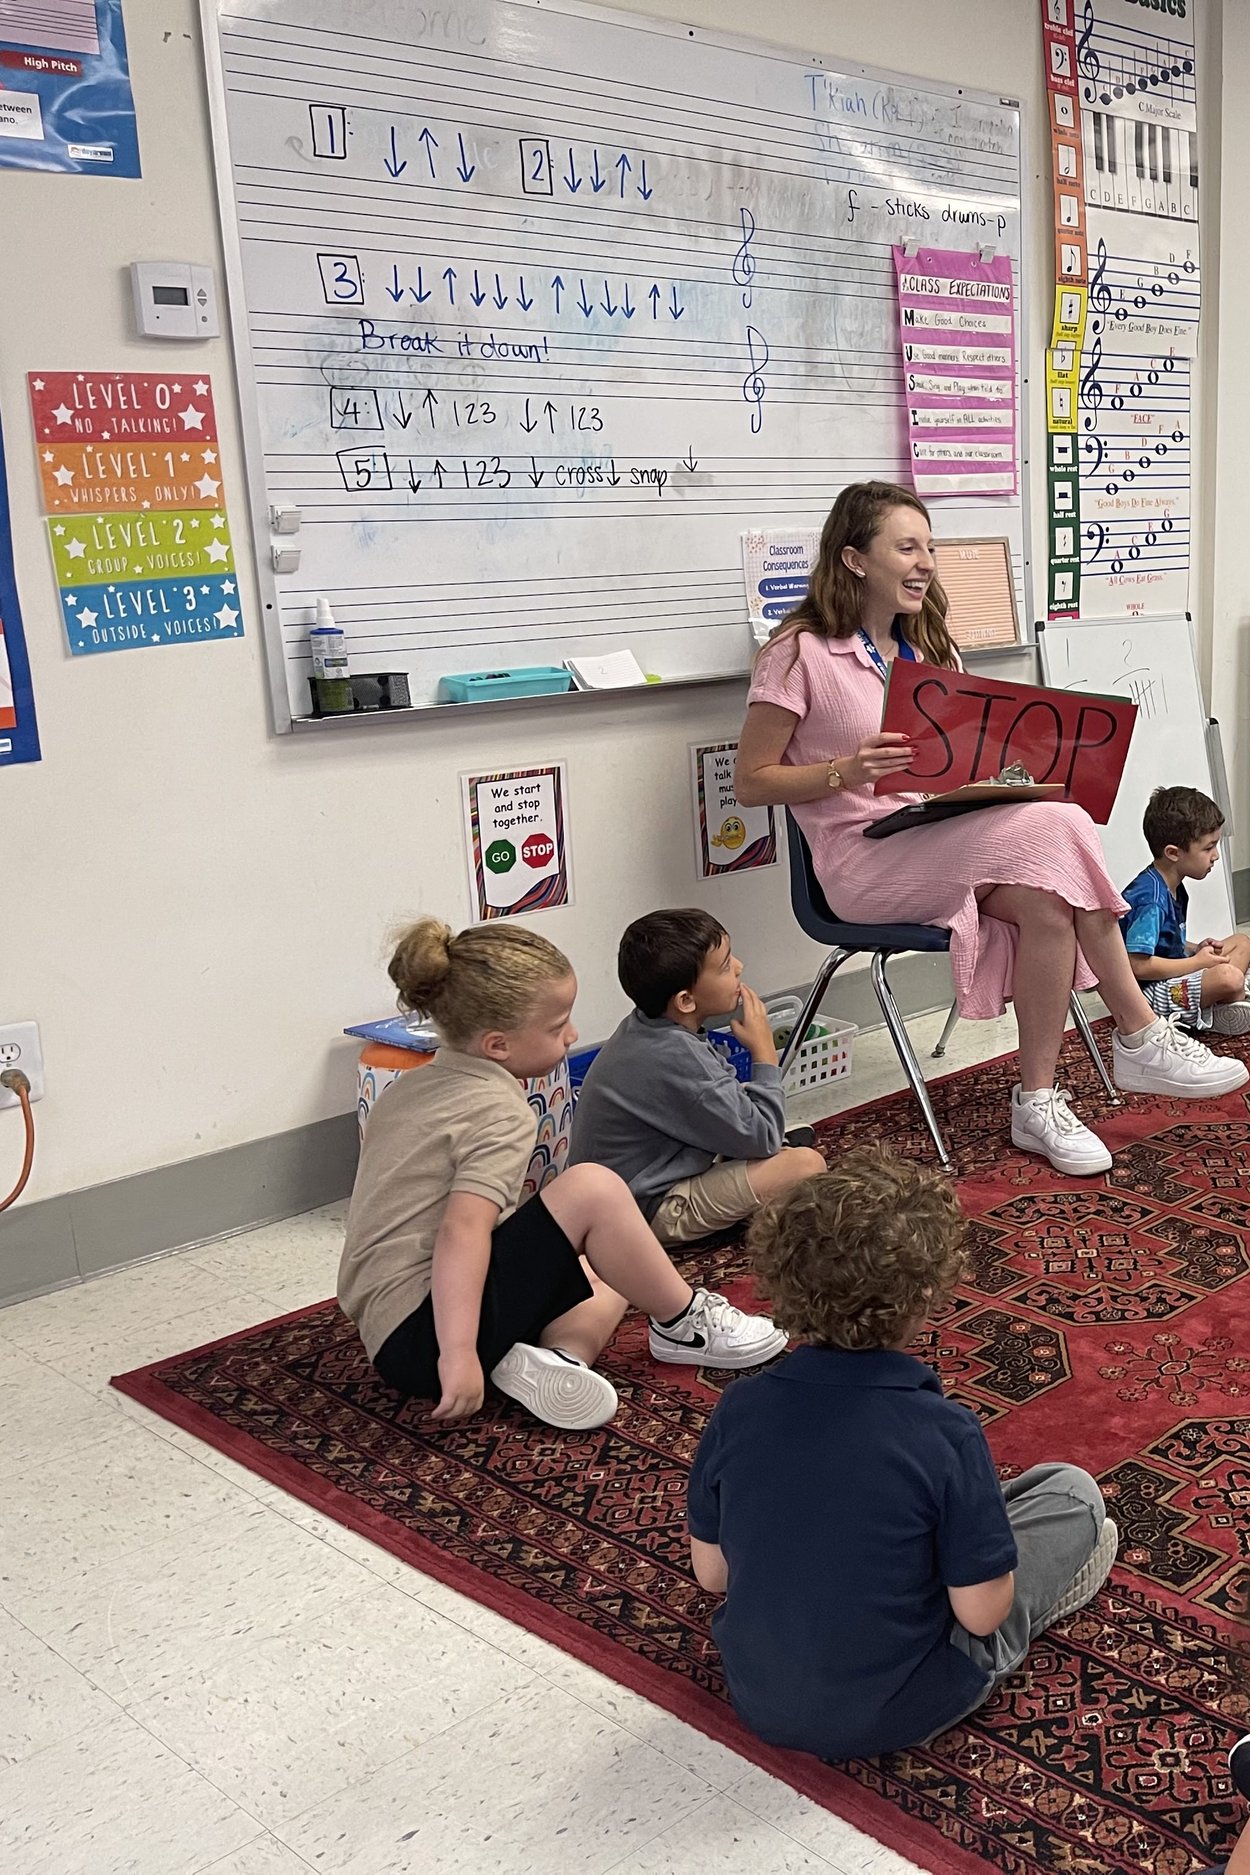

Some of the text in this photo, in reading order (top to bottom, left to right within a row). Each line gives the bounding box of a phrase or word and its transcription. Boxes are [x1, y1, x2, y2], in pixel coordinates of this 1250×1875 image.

[24, 57, 77, 72] High Pitch
[887, 198, 931, 220] sticks
[1090, 189, 1097, 200] C
[1104, 192, 1111, 202] D
[1118, 194, 1124, 205] E
[1158, 201, 1165, 212] A
[1171, 202, 1177, 213] B
[1183, 205, 1190, 215] C
[1119, 250, 1191, 300] E G B D F
[909, 277, 1010, 300] CLASS EXPECTATIONS
[904, 309, 986, 328] Make Good Choices
[1128, 322, 1145, 332] Good
[359, 319, 551, 363] Break it down!
[72, 383, 142, 410] LEVEL
[74, 416, 177, 434] NO TALKING!
[453, 402, 498, 427] 123
[570, 407, 604, 433] 123
[82, 452, 175, 480] LEVEL 1
[462, 456, 512, 489] 123
[555, 464, 604, 487] cross
[629, 464, 669, 497] snap
[70, 485, 196, 504] WHISPERS ONLY!
[92, 519, 186, 550] LEVEL 2
[770, 545, 803, 556] Classroom
[87, 551, 201, 575] GROUP VOICES!
[763, 560, 809, 573] Consequences
[103, 586, 197, 620] LEVEL 3
[1050, 603, 1066, 611] eighth
[91, 618, 218, 645] OUTSIDE VOICES!
[902, 678, 1119, 799] STOP
[715, 757, 730, 767] We
[715, 770, 731, 780] talk
[491, 783, 541, 798] We start
[494, 799, 540, 813] and stop
[493, 813, 543, 830] together.
[492, 843, 553, 862] GO STOP
